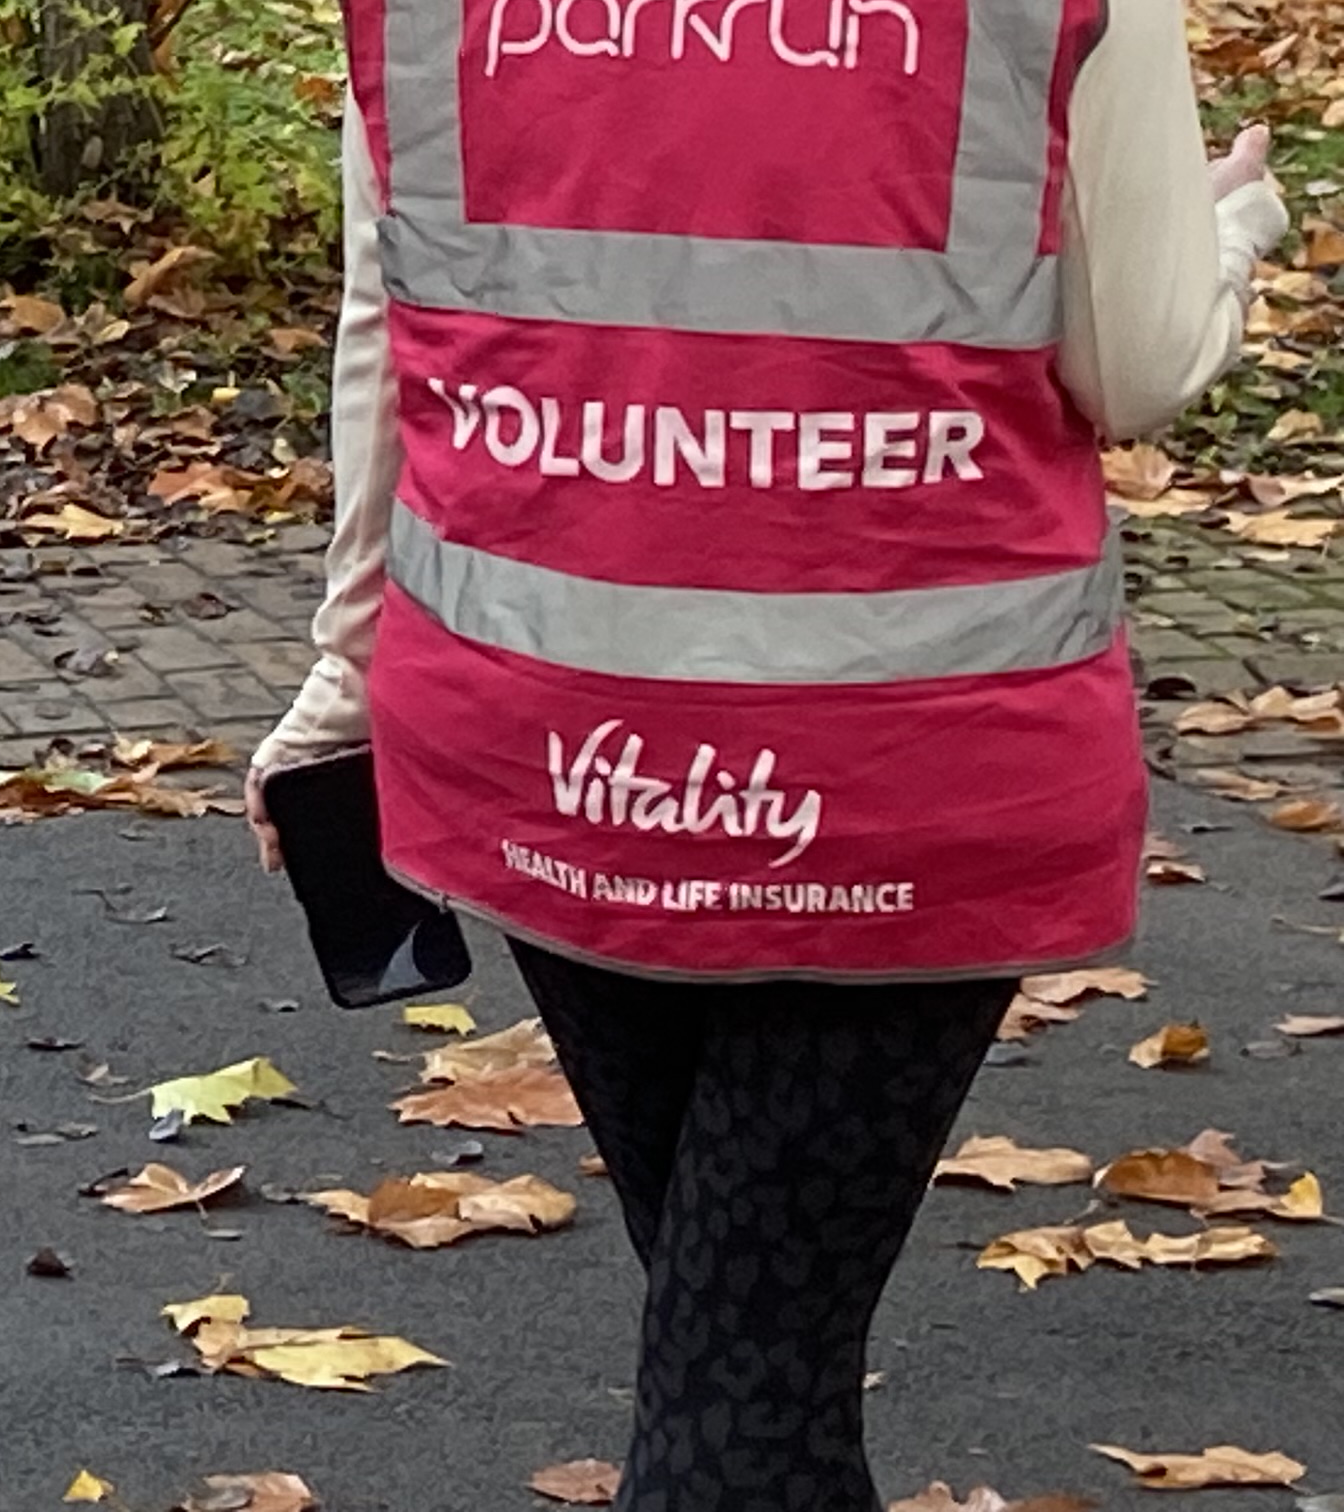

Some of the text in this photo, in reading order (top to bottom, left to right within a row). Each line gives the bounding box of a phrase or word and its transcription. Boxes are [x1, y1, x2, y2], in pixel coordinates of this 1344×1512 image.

[428, 377, 985, 491] VOLUNTEER
[547, 719, 822, 870] Vitality
[502, 838, 915, 913] HEALTH AND LIFE INSURANCE
